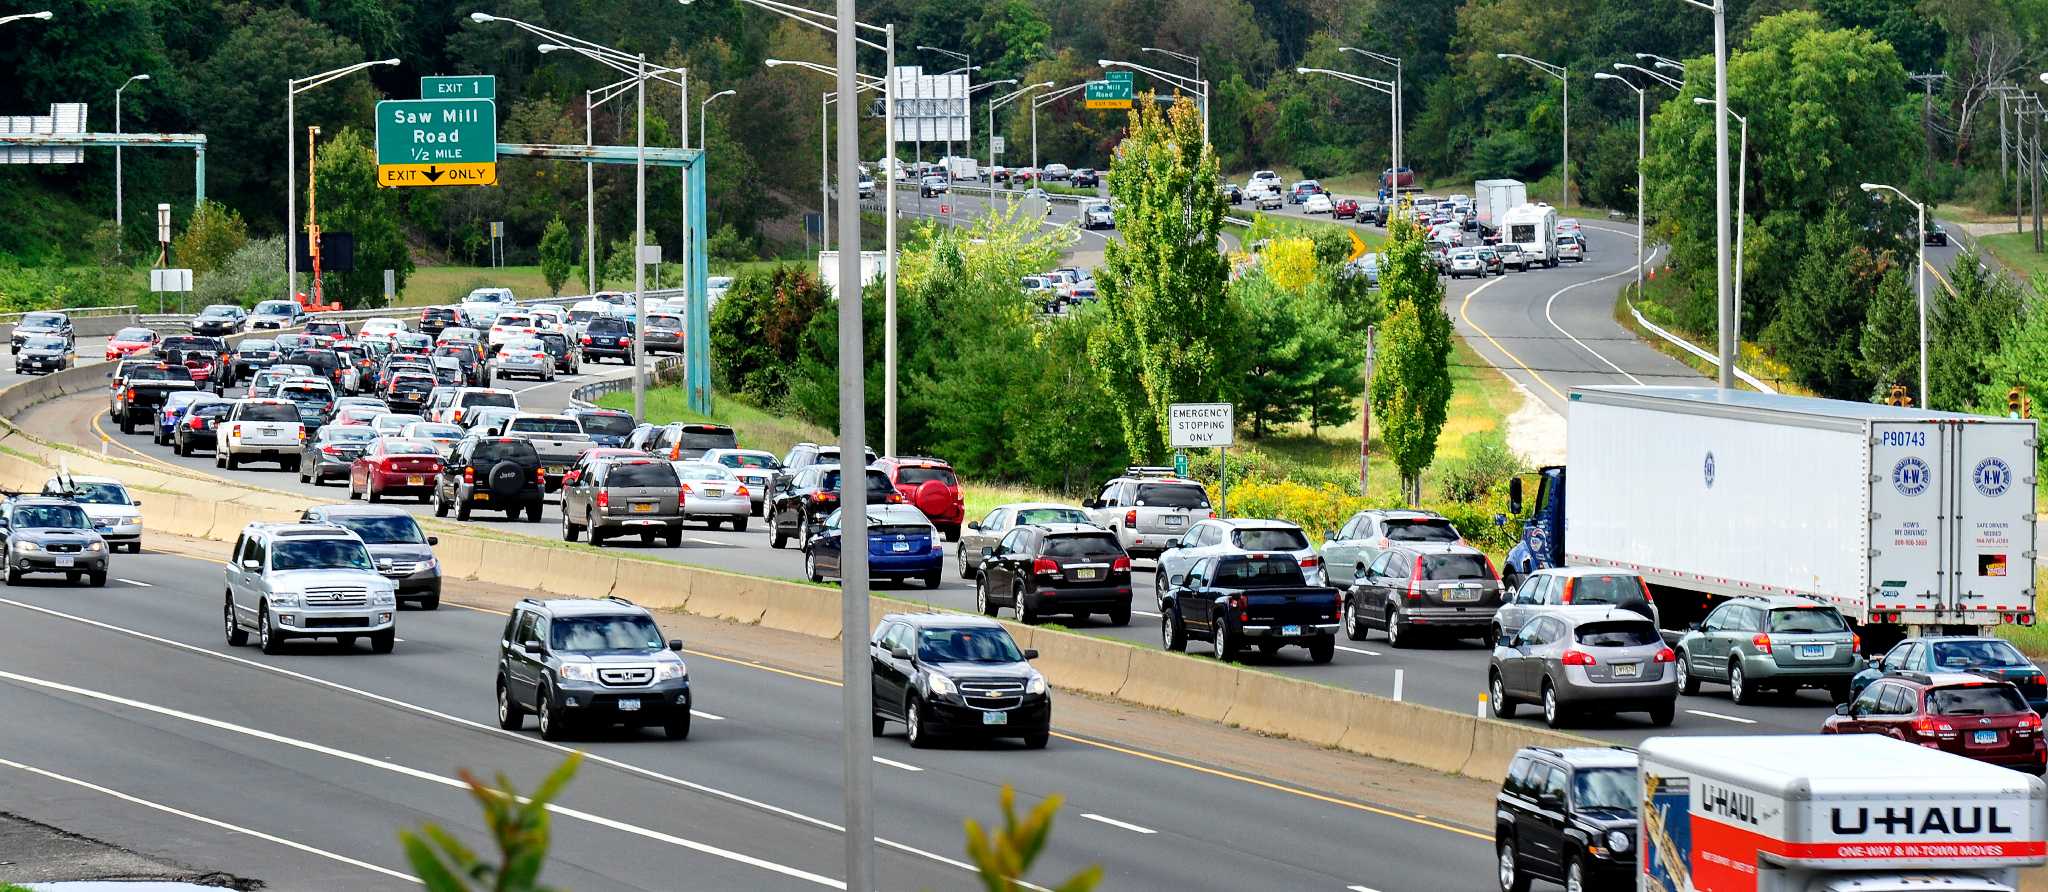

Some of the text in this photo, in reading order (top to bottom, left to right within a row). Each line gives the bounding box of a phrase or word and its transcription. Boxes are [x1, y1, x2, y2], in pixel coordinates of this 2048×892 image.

[438, 81, 479, 94] EXIT 1
[394, 108, 478, 124] Saw Mill
[413, 129, 459, 143] Road
[435, 149, 462, 158] MILE
[387, 169, 486, 181] EXIT ONLY
[1173, 409, 1229, 418] EMERGENCY
[1179, 421, 1225, 430] STOPPING
[1190, 433, 1214, 442] ONLY
[1883, 431, 1926, 447] P90743
[1702, 783, 1758, 825] U-HAUL
[1831, 807, 2012, 834] U-HAUL
[1838, 845, 2004, 857] ONE-WAY & IN-TOWN MOVES
